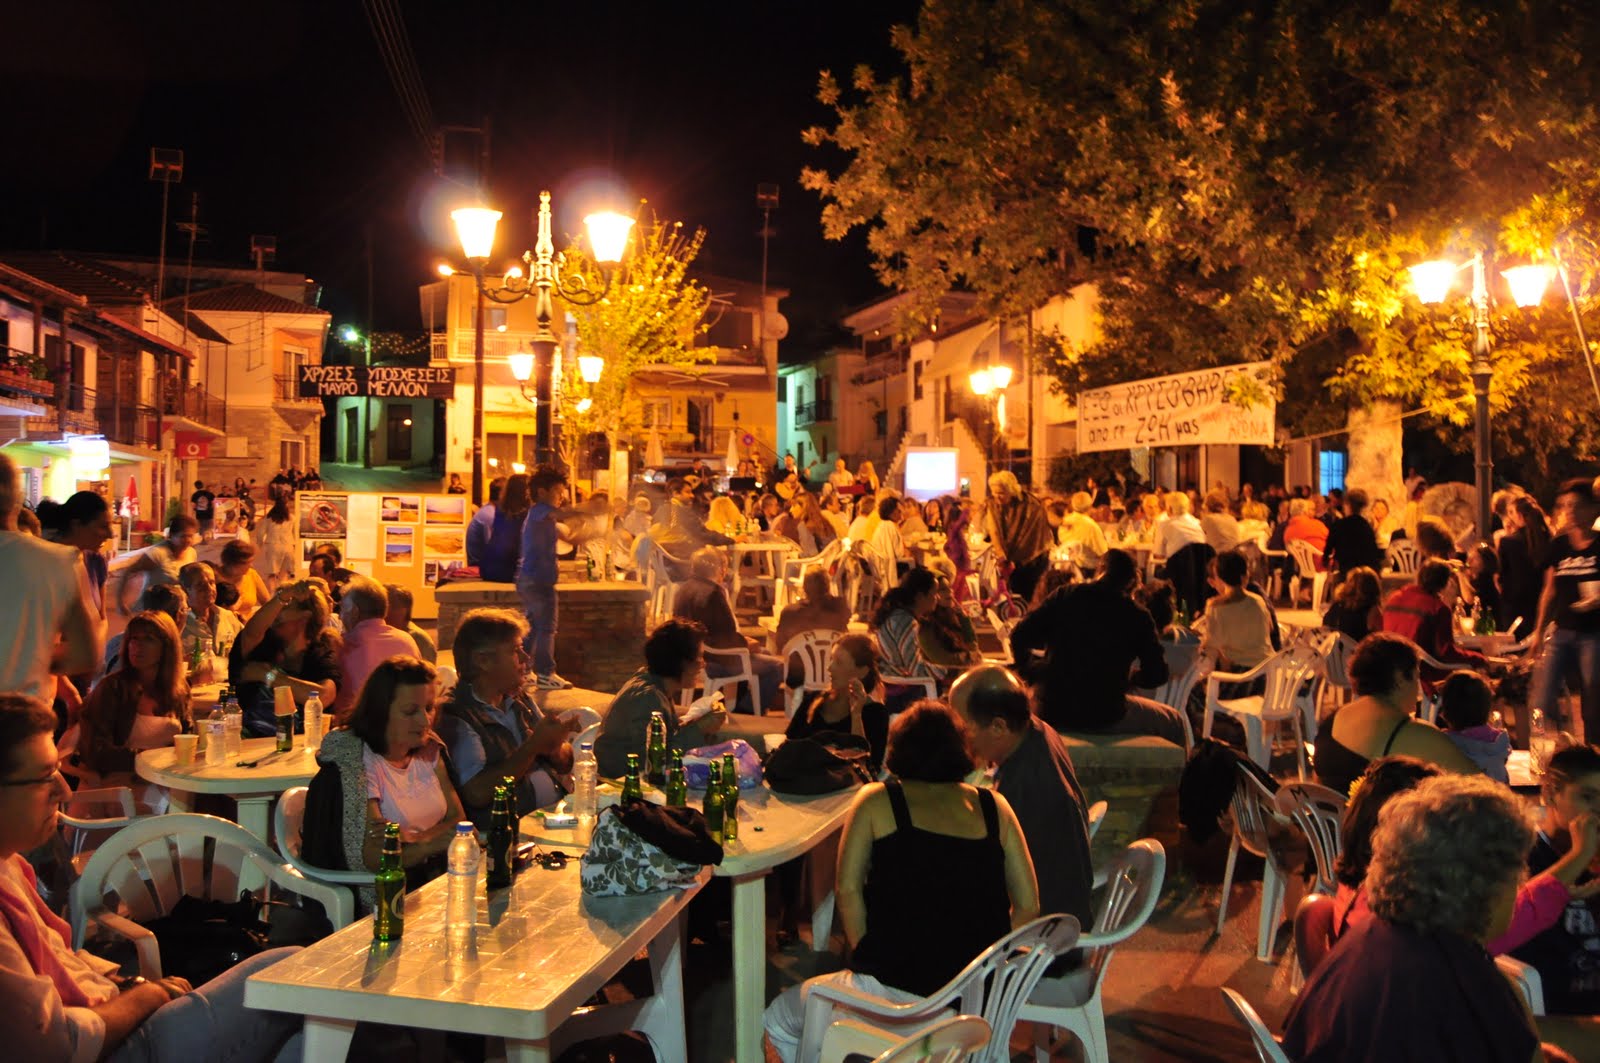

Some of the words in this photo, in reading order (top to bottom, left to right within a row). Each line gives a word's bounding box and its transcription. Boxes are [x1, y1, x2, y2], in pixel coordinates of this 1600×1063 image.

[302, 366, 356, 383] ΧΡΥΣΕΣ
[367, 367, 451, 383] ΥΠΟΣΧΕΣΕΙΣ
[318, 382, 358, 396] ΜΑΥΡΟ
[367, 381, 428, 397] ΜΕΛΛΟΝ
